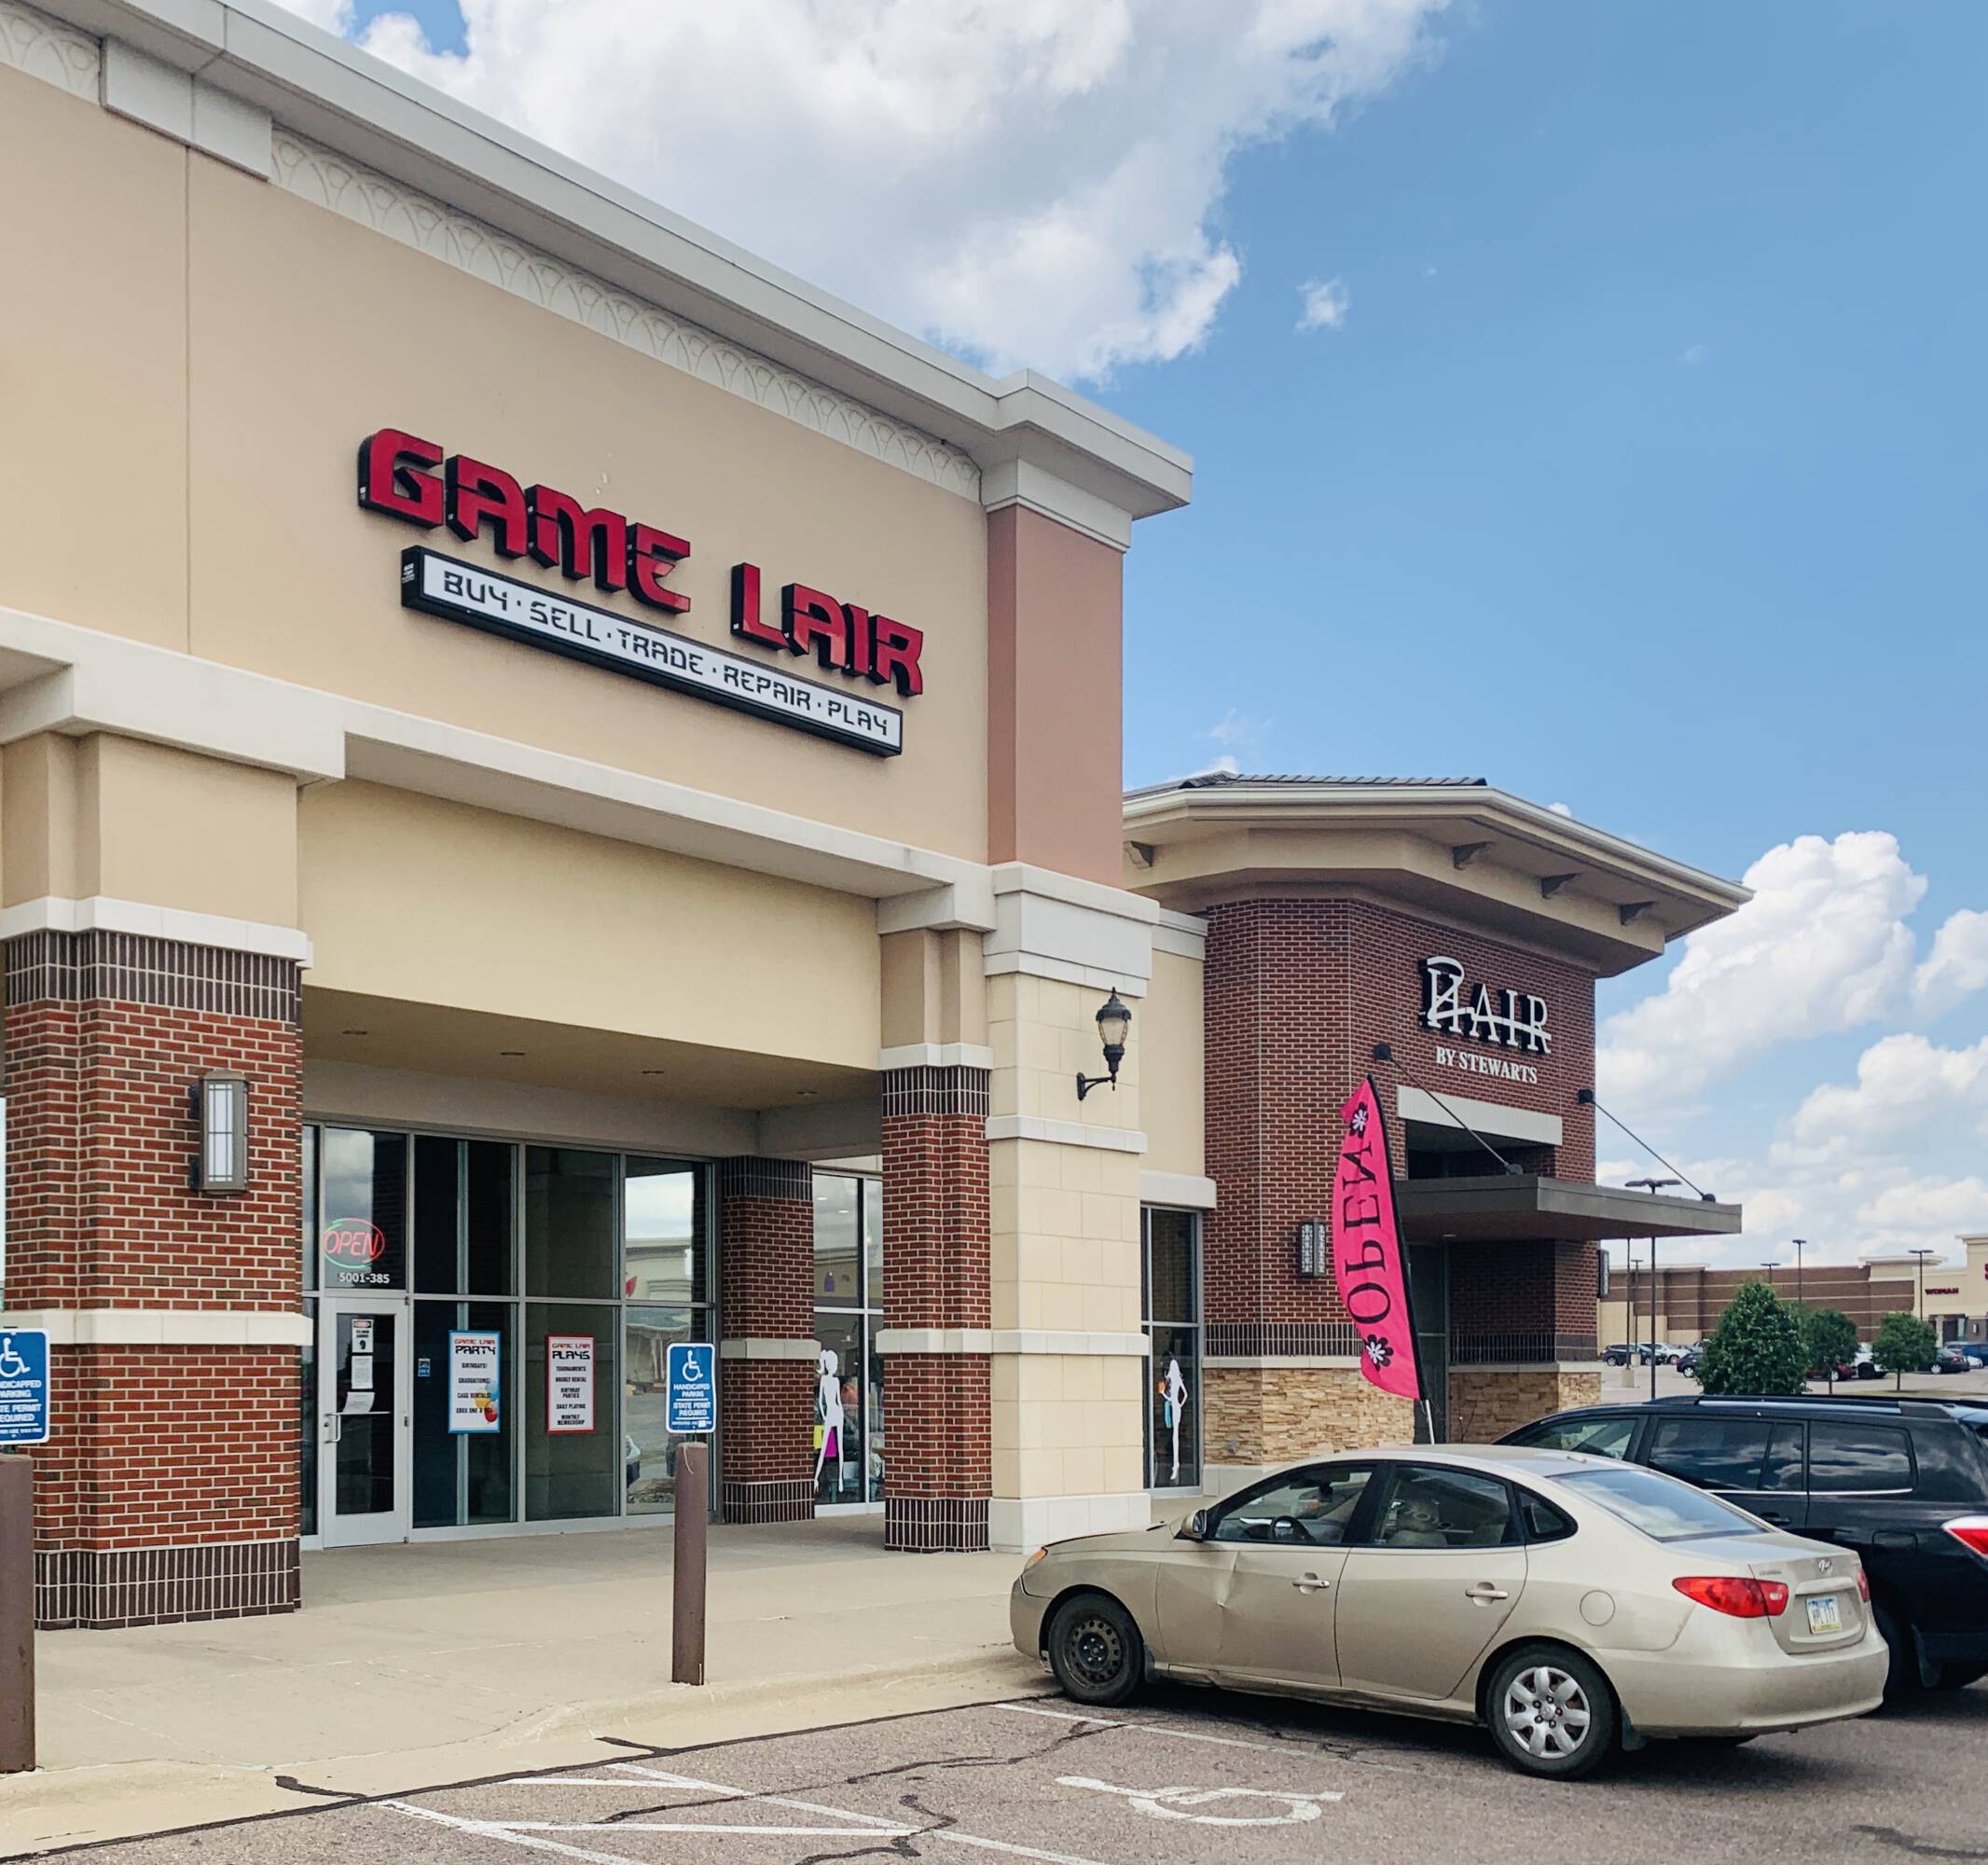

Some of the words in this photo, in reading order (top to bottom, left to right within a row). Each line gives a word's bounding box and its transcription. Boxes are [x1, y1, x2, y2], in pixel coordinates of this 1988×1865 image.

[358, 428, 690, 615] GAME
[731, 562, 923, 697] LAIR
[443, 570, 508, 612] BUY
[530, 601, 601, 642] SELL
[616, 628, 703, 676] TRADE
[723, 664, 811, 711] REPAIR
[827, 698, 888, 736] PLAY
[1436, 1045, 1456, 1068] BY
[1458, 1051, 1539, 1084] STEWARTS
[324, 1231, 380, 1256] OPEN
[338, 1271, 390, 1284] 5001-385
[455, 1346, 496, 1356] PARTY
[552, 1350, 590, 1360] PLAYS
[12, 1403, 42, 1412] PERMIT
